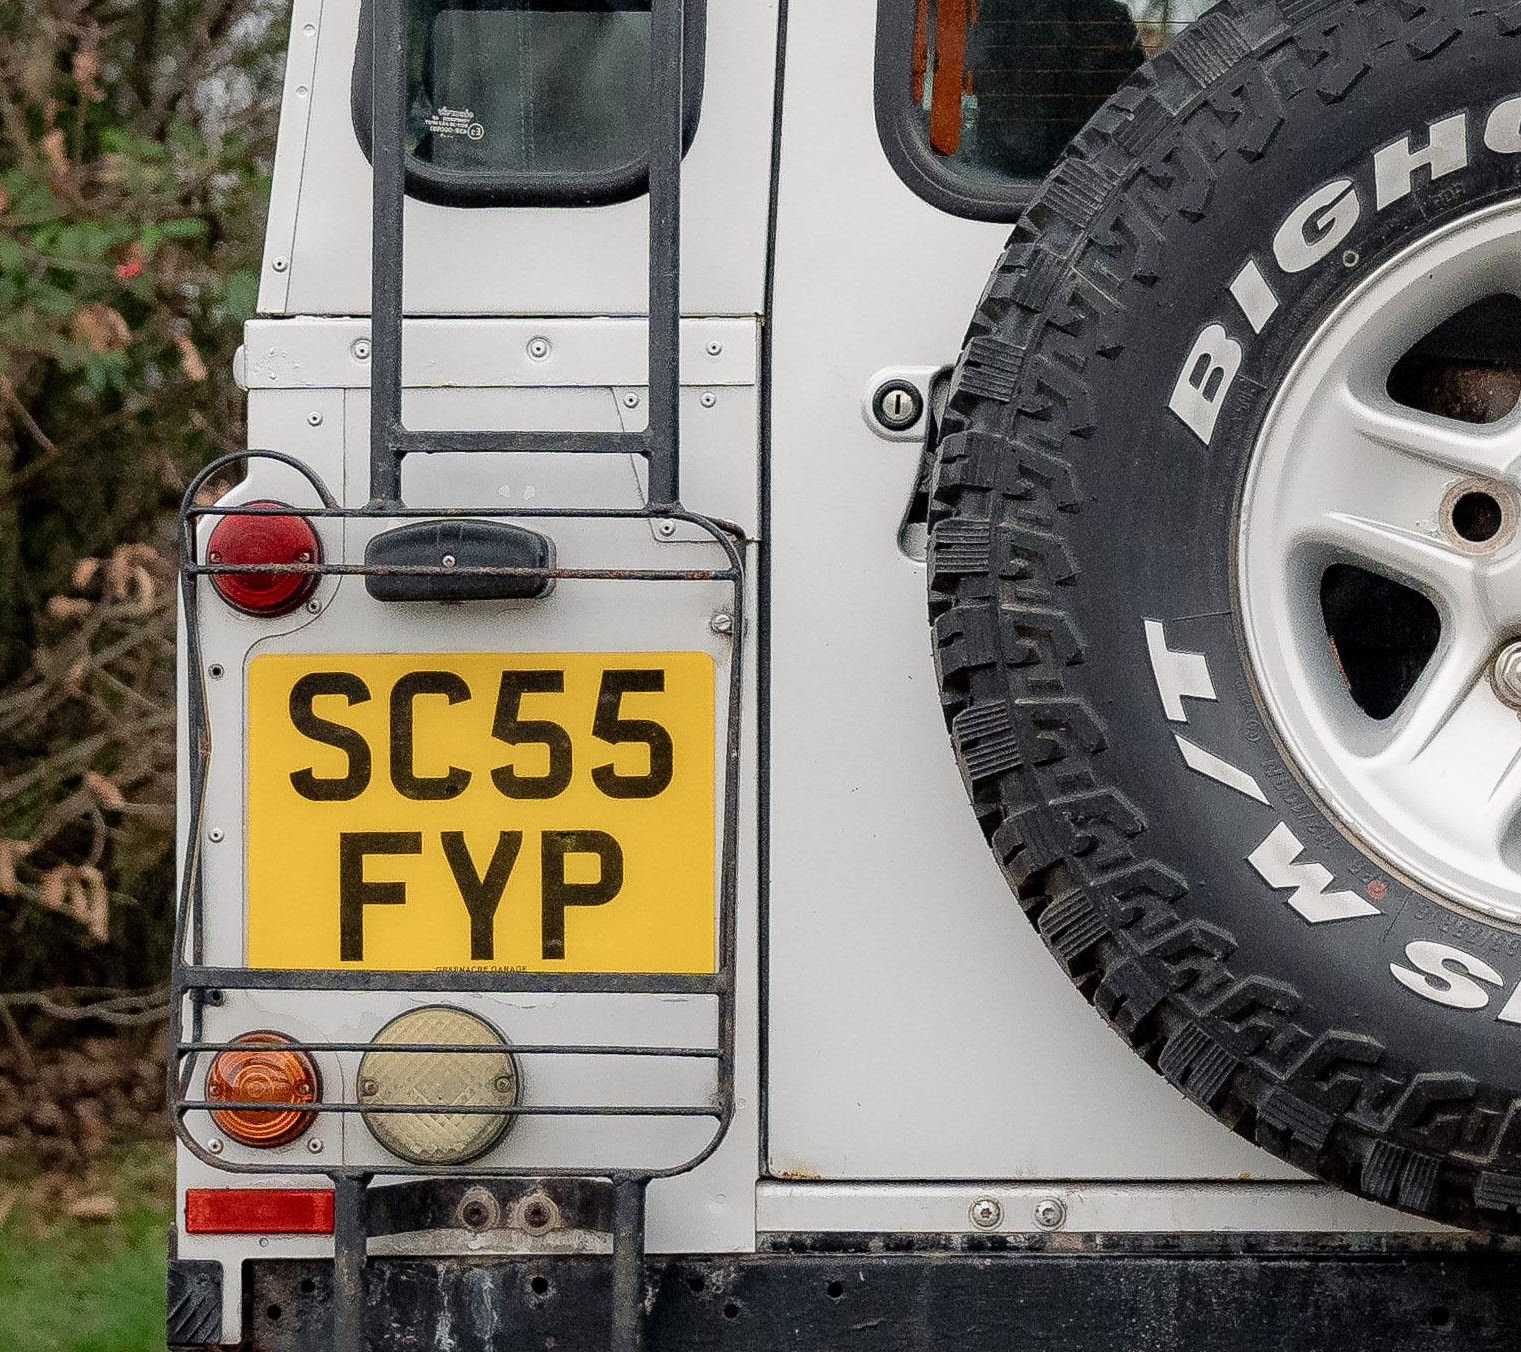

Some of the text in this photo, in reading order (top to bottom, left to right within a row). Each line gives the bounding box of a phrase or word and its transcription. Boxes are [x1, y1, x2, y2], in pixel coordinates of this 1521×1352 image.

[288, 669, 674, 802] SC55
[1143, 619, 1383, 925] M/T
[339, 829, 624, 963] FYP
